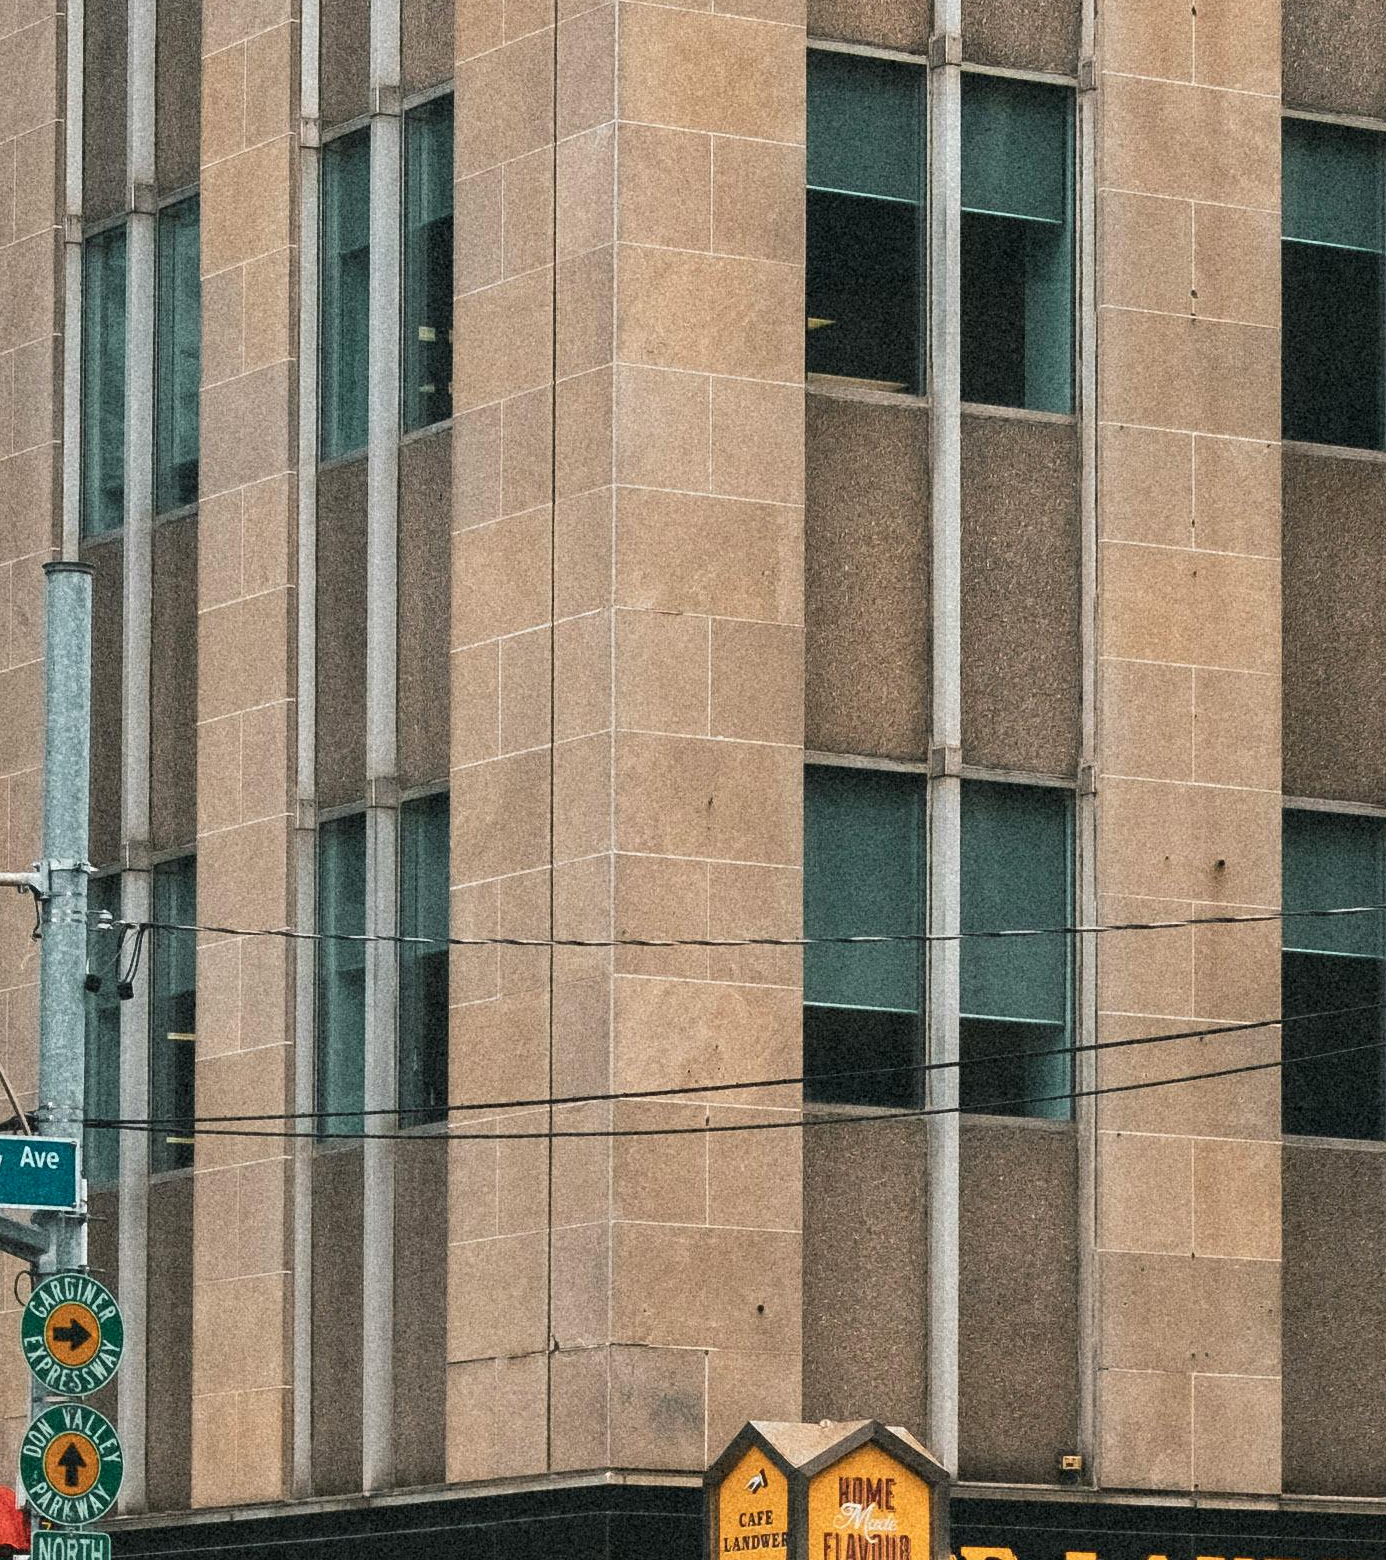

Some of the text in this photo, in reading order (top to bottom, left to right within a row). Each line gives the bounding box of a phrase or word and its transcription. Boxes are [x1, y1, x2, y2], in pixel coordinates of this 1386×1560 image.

[19, 1145, 61, 1170] Ave
[29, 1277, 117, 1323] GARDINER
[24, 1336, 121, 1393] EXPRESSWAY
[23, 1407, 122, 1462] DON VALLEY
[29, 1482, 111, 1521] PARKWAY
[838, 1476, 897, 1513] HOME
[739, 1509, 774, 1528] CAFE
